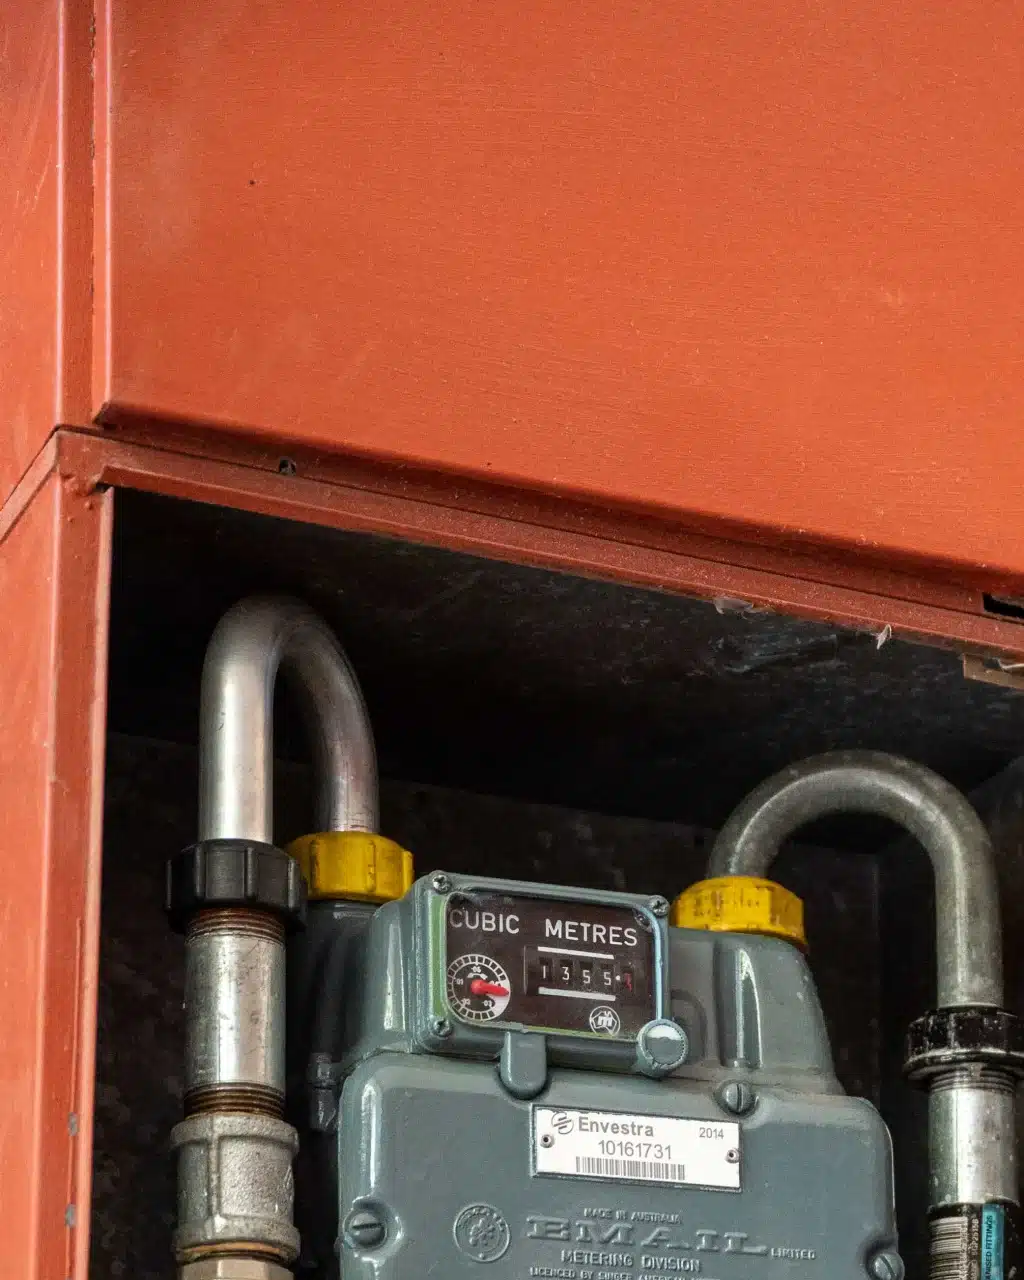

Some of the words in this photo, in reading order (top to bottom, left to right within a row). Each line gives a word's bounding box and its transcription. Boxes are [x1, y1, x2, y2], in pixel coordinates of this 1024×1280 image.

[449, 908, 520, 934] CUBIC
[545, 918, 638, 947] METRES
[578, 1116, 654, 1138] Envestra
[699, 1127, 725, 1140] 2014
[598, 1139, 672, 1160] 10161731
[583, 1207, 612, 1219] MADE
[615, 1209, 627, 1221] IN
[631, 1211, 681, 1225] AUSTRALIA
[985, 1215, 993, 1250] FITTINGS
[560, 1249, 633, 1268] METERING
[641, 1254, 701, 1273] DIVISION
[770, 1247, 816, 1261] LIMITED
[529, 1266, 576, 1279] LICENCED
[580, 1270, 594, 1280] BY
